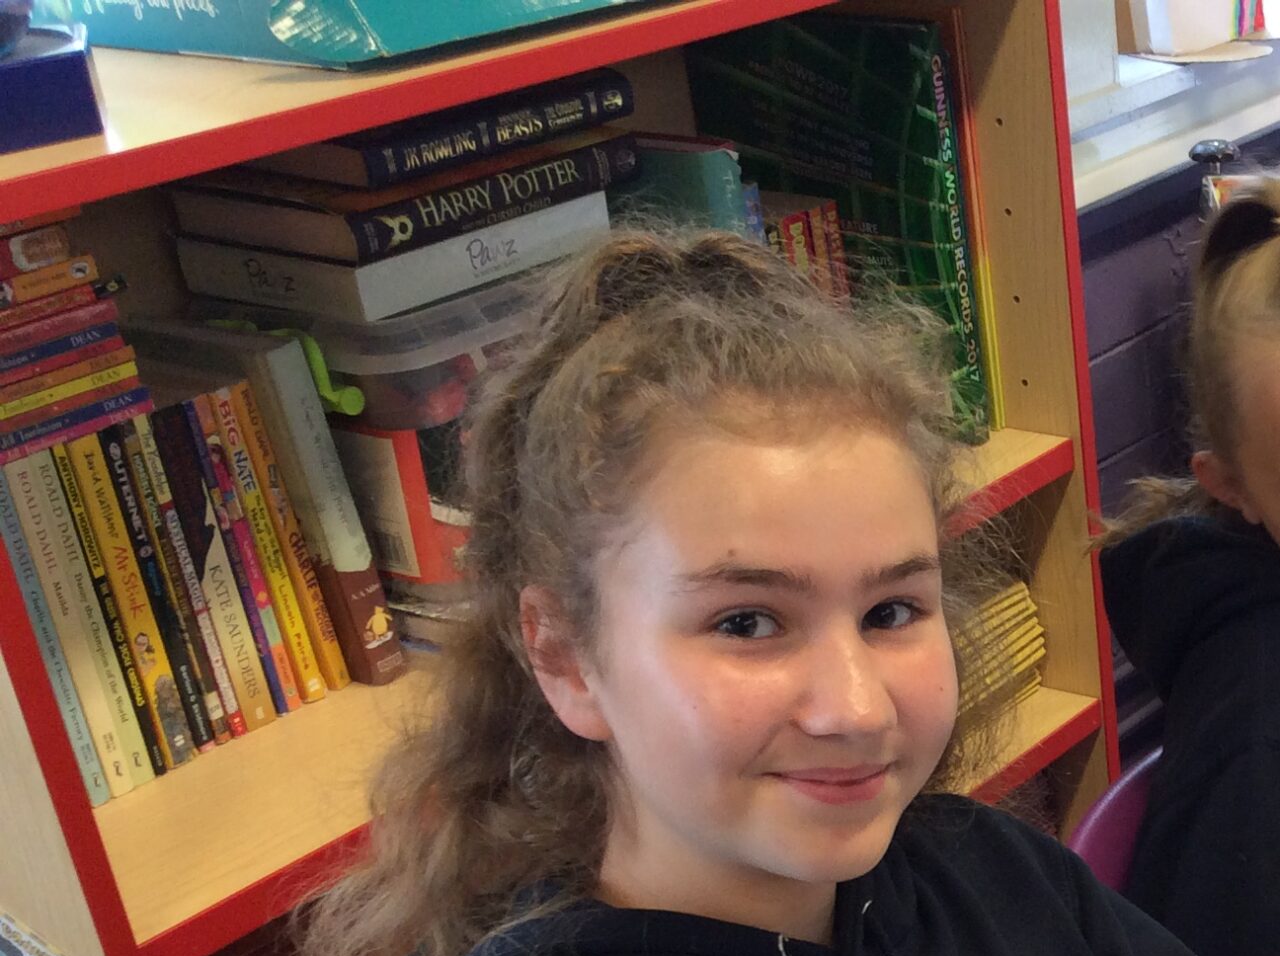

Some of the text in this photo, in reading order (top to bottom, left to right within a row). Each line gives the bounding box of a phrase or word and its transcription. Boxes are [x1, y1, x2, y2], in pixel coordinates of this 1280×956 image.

[422, 131, 477, 166] ROWLING
[496, 118, 543, 144] BEASTS
[415, 180, 493, 228] HARRY
[498, 158, 581, 202] POTTER
[930, 54, 980, 382] GUINNESS WORLD RECORDS 2017
[70, 330, 102, 347] DEAN
[91, 369, 121, 386] DEAN
[103, 394, 133, 412] DEAN
[107, 441, 146, 543] OUTERNET
[133, 454, 161, 527] HORRIBLE SCIENCE
[232, 449, 257, 491] NATE
[0, 478, 19, 532] OALD
[13, 538, 35, 585] DAHL
[17, 470, 69, 616] ROALD DAHL Matilda
[58, 455, 100, 570] ANTHONY HOROWITZ
[95, 487, 119, 539] Walliams
[249, 507, 263, 534] Head
[38, 463, 128, 723] ROALD DAHL Danny the Champion of the World
[112, 544, 148, 618] Mr Stink
[165, 511, 191, 570] MYSTICAL
[185, 571, 203, 607] MAGIC
[288, 530, 317, 589] CHARLIE
[111, 620, 125, 642] WHO
[118, 643, 133, 666] STOLE
[208, 563, 234, 611] KATE
[222, 612, 261, 699] SAUNDERS
[277, 584, 310, 670] Lincoln Peirce
